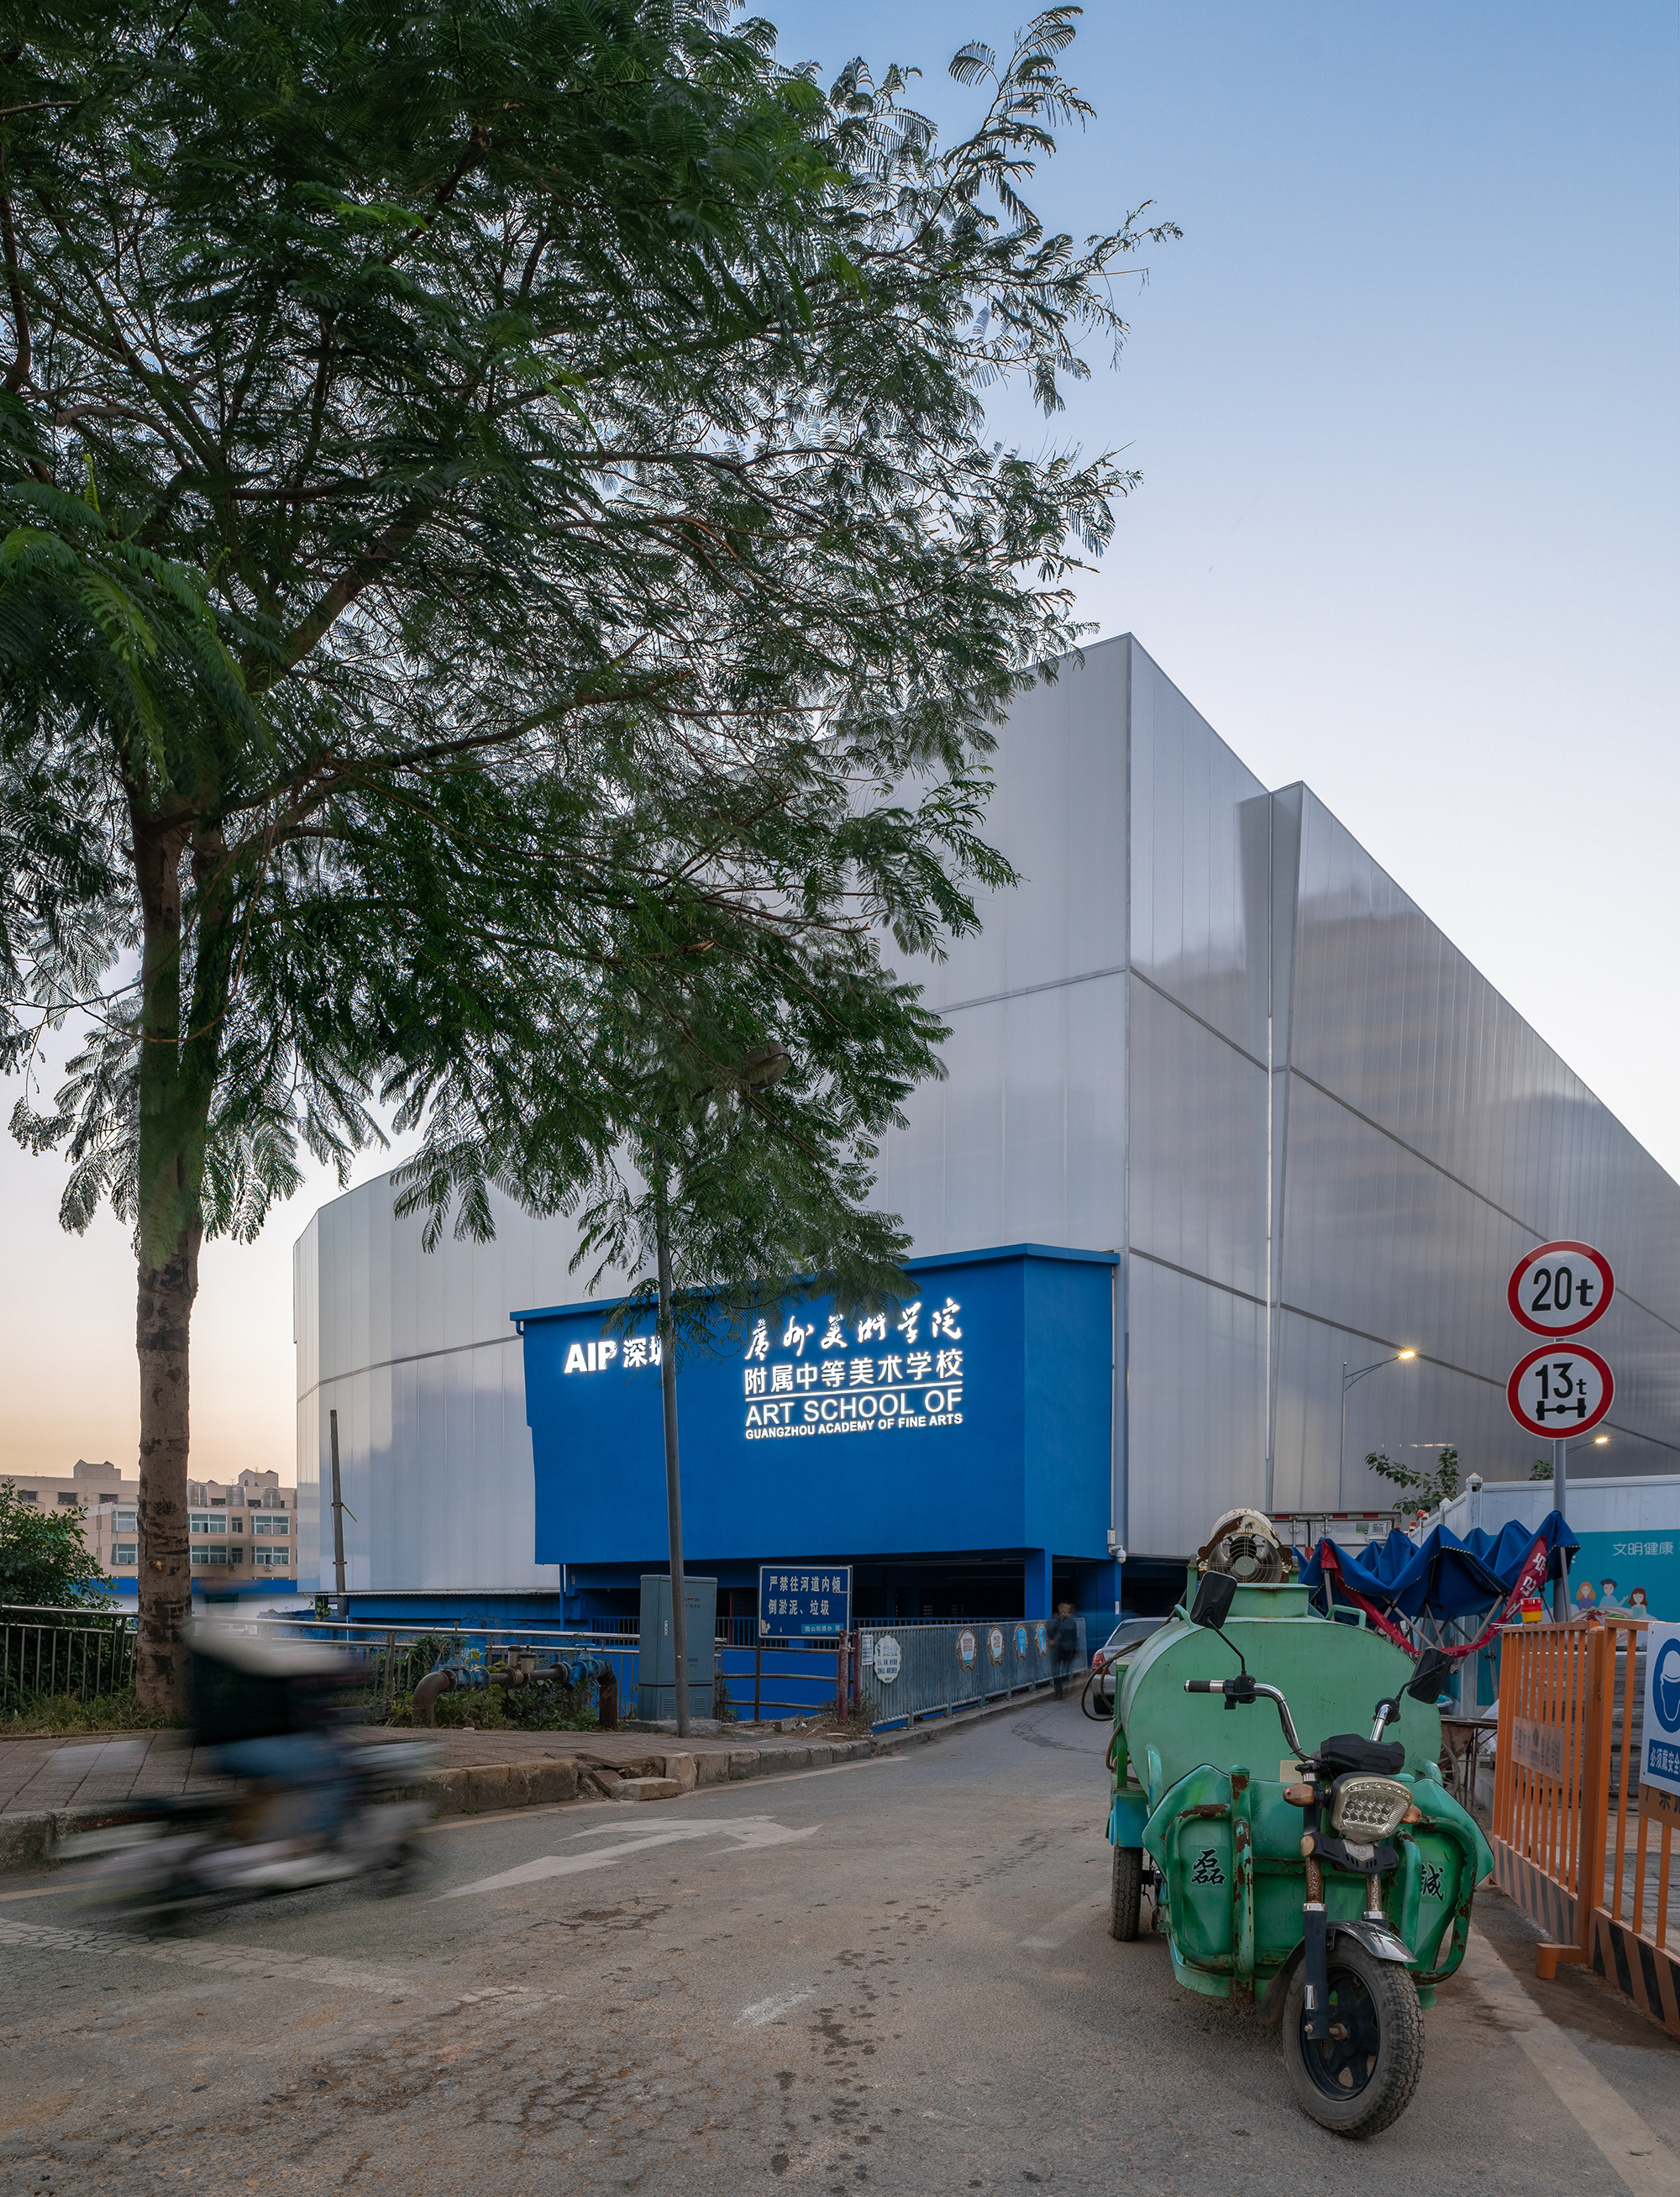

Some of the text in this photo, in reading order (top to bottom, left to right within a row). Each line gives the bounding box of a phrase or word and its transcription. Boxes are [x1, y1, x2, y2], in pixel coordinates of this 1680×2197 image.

[1530, 1267, 1593, 1311] 20t
[564, 1340, 617, 1374] AIP
[745, 1348, 963, 1395] 附属中等美术学校
[1535, 1362, 1587, 1400] 13t
[745, 1388, 963, 1427] ART SCHOOL OF
[745, 1413, 963, 1440] GUANGZHOU ACADEMY OF FINE ARTS
[1613, 1542, 1674, 1556] 文明健康
[769, 1576, 841, 1592] 严禁往河道内倾
[768, 1599, 830, 1616] 倒淤泥、垃圾
[1649, 1747, 1680, 1775] 必须戴安全
